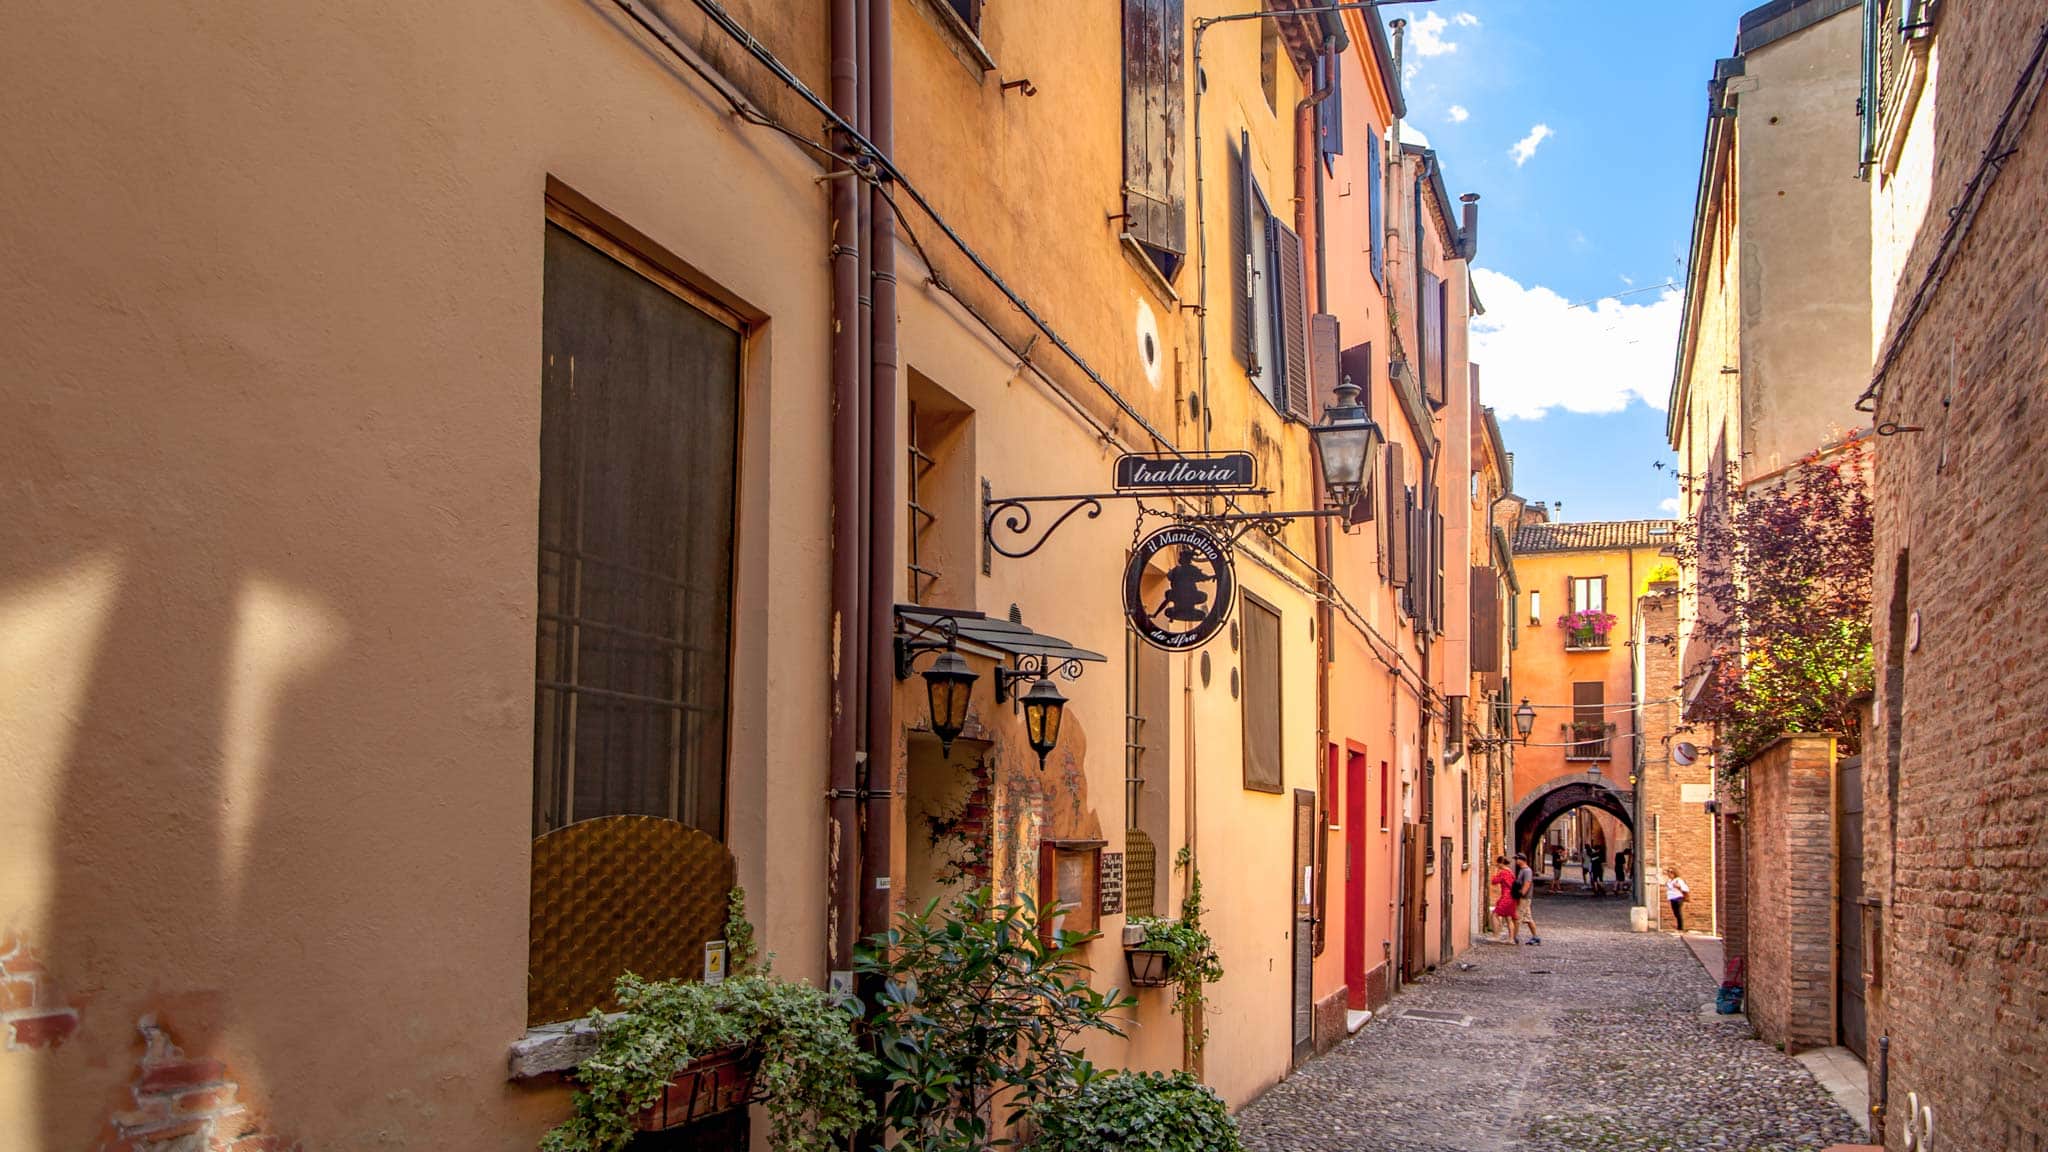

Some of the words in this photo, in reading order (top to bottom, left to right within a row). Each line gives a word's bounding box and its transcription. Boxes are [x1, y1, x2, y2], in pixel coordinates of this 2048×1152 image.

[1134, 463, 1236, 482] trattoria
[1147, 540, 1158, 553] il
[1160, 532, 1218, 560] Mandolino
[1151, 630, 1167, 641] da
[1166, 634, 1198, 648] Afra
